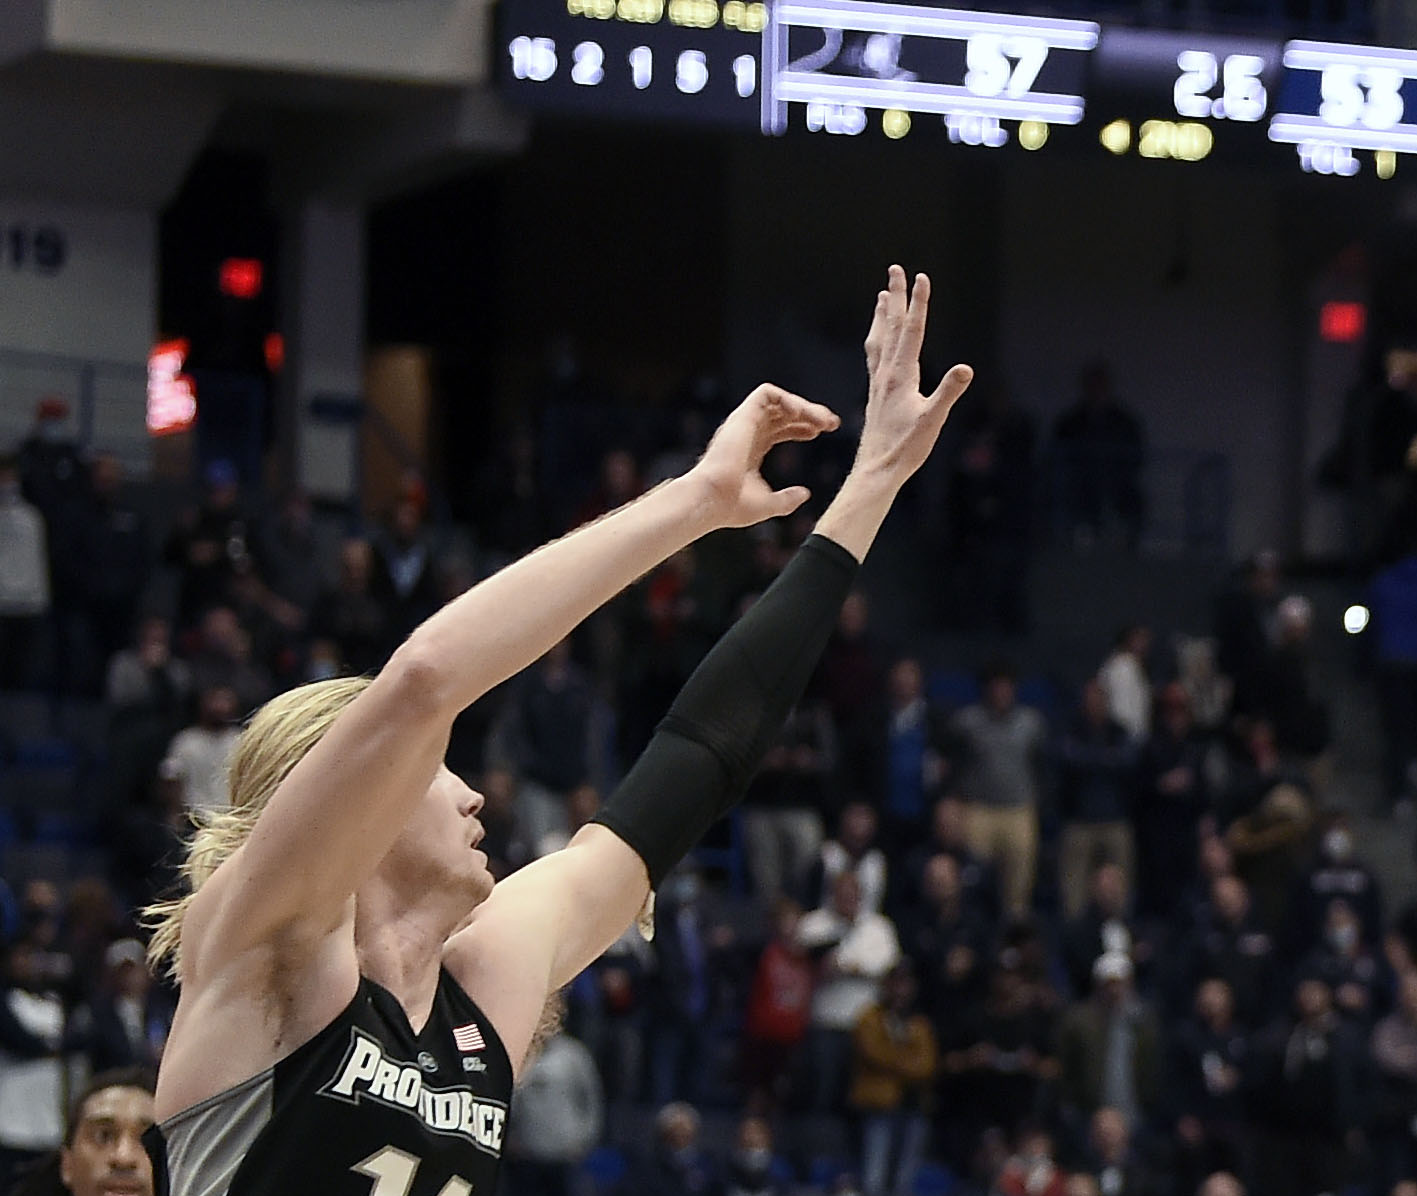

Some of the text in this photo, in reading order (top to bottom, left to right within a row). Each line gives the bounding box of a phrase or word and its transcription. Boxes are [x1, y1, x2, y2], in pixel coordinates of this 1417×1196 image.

[629, 46, 652, 89] 1
[733, 55, 756, 97] 1
[965, 33, 1049, 97] 57
[1174, 51, 1267, 122] 2.6
